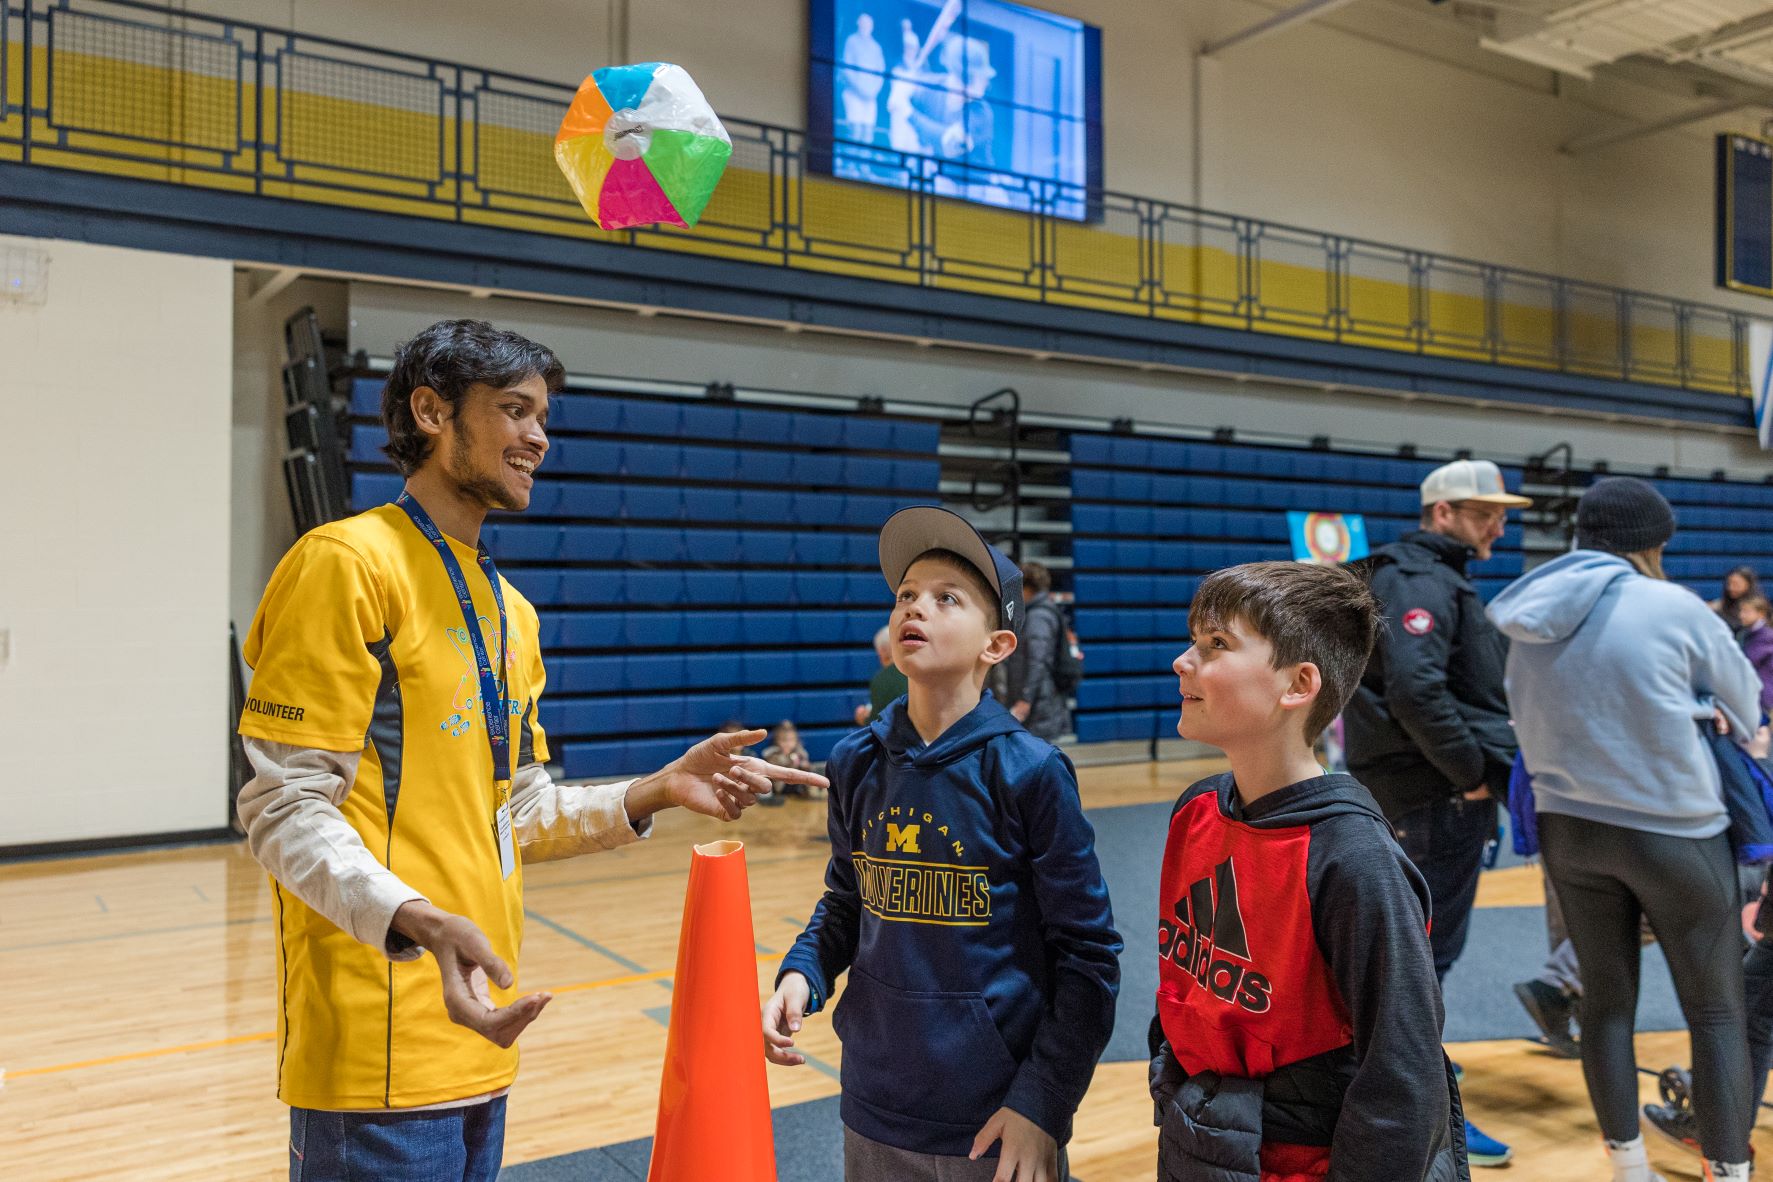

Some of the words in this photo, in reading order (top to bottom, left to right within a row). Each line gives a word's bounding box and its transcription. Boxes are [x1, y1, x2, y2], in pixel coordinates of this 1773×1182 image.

[485, 701, 496, 736] experience
[493, 715, 501, 735] center
[1159, 919, 1273, 1014] adidas
